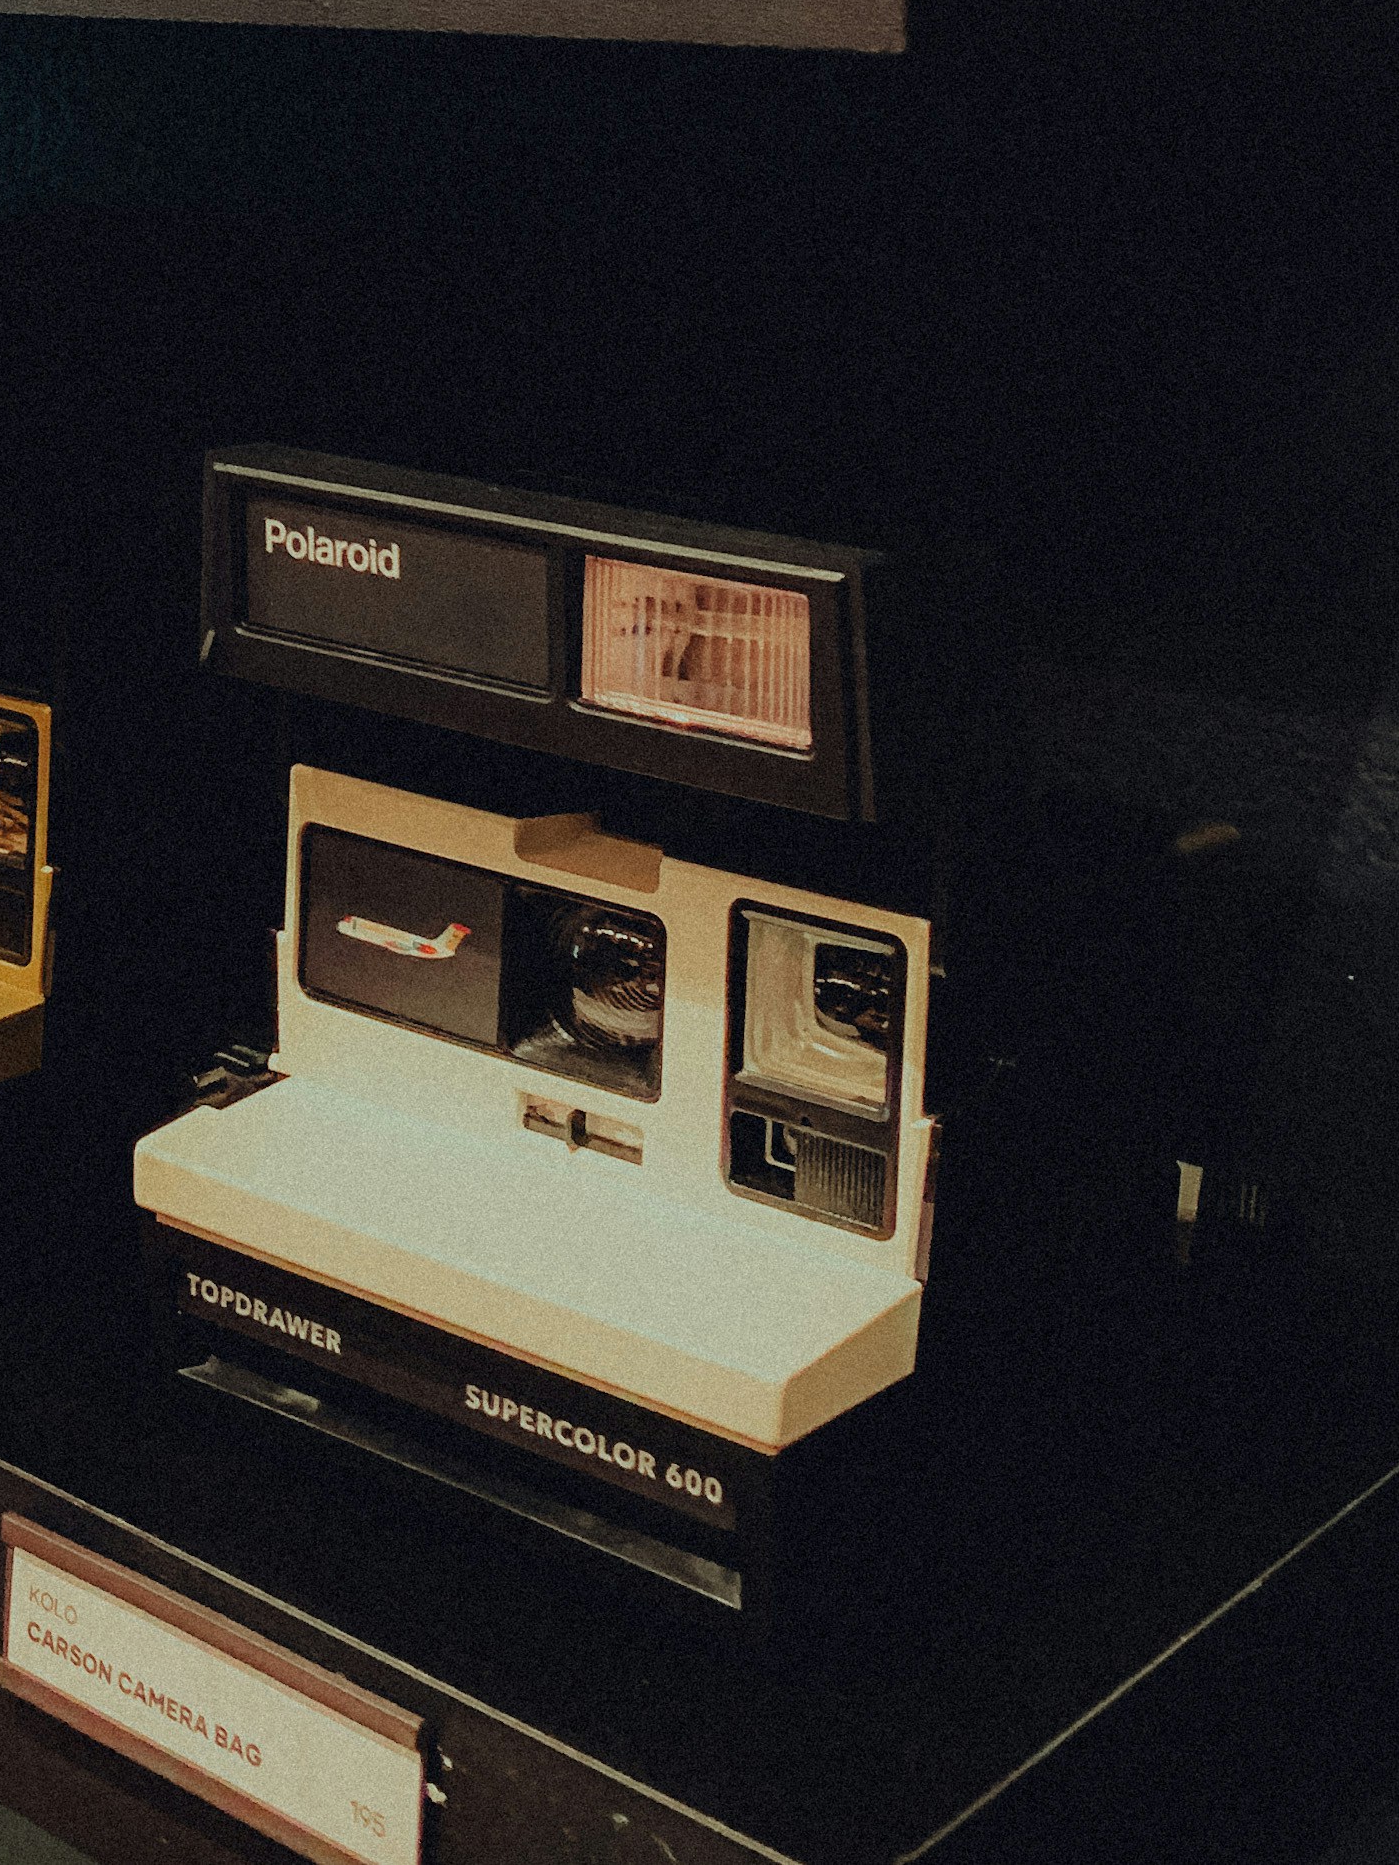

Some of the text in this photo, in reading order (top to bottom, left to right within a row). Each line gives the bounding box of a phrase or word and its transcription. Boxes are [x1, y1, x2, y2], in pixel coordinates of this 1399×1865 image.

[265, 518, 401, 579] Polaroid
[187, 1272, 722, 1504] TOPDRAWER SUPERCOLOR 600
[28, 1584, 78, 1626] KOLO
[27, 1621, 263, 1767] CARSON CAMERA BAG
[349, 1799, 386, 1837] 195
